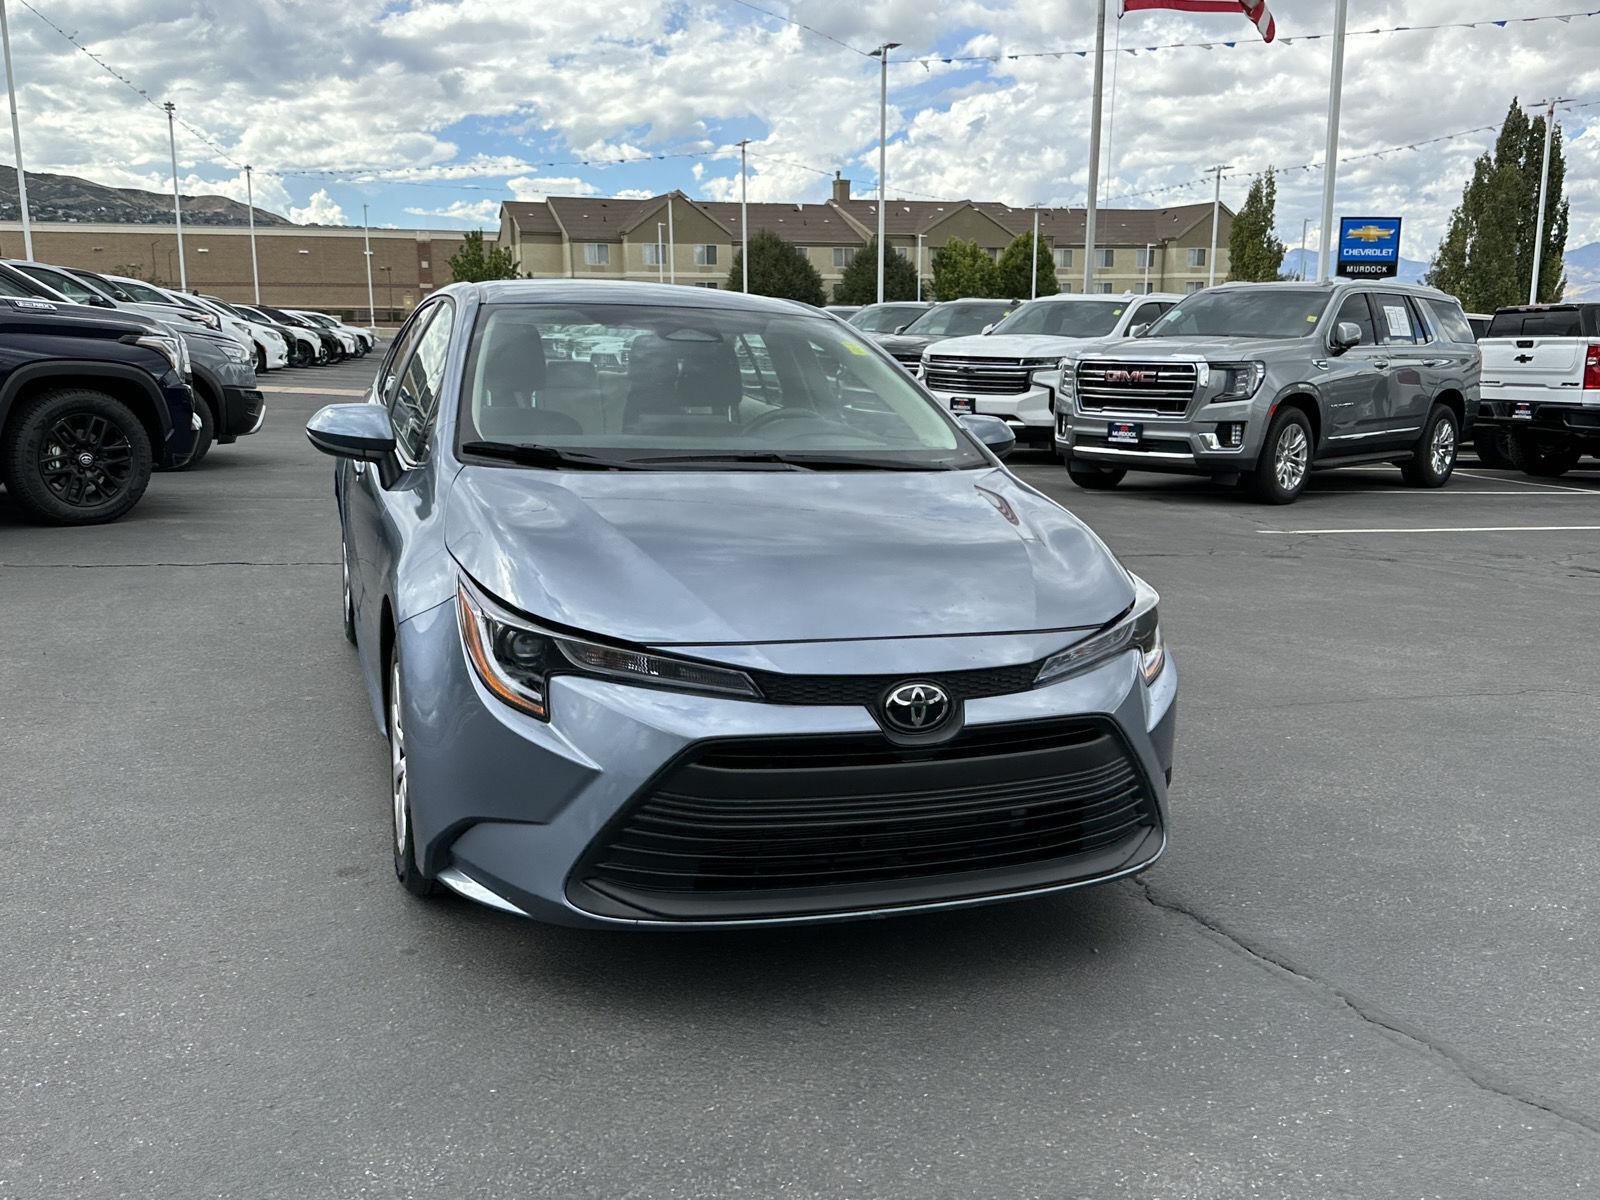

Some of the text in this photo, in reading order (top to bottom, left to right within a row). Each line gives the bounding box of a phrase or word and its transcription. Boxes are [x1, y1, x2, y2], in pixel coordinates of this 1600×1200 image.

[1343, 248, 1394, 257] CHEVROLET
[1346, 265, 1388, 273] MURDOCK
[1105, 370, 1156, 382] GMC
[1112, 430, 1137, 438] MURDOCK
